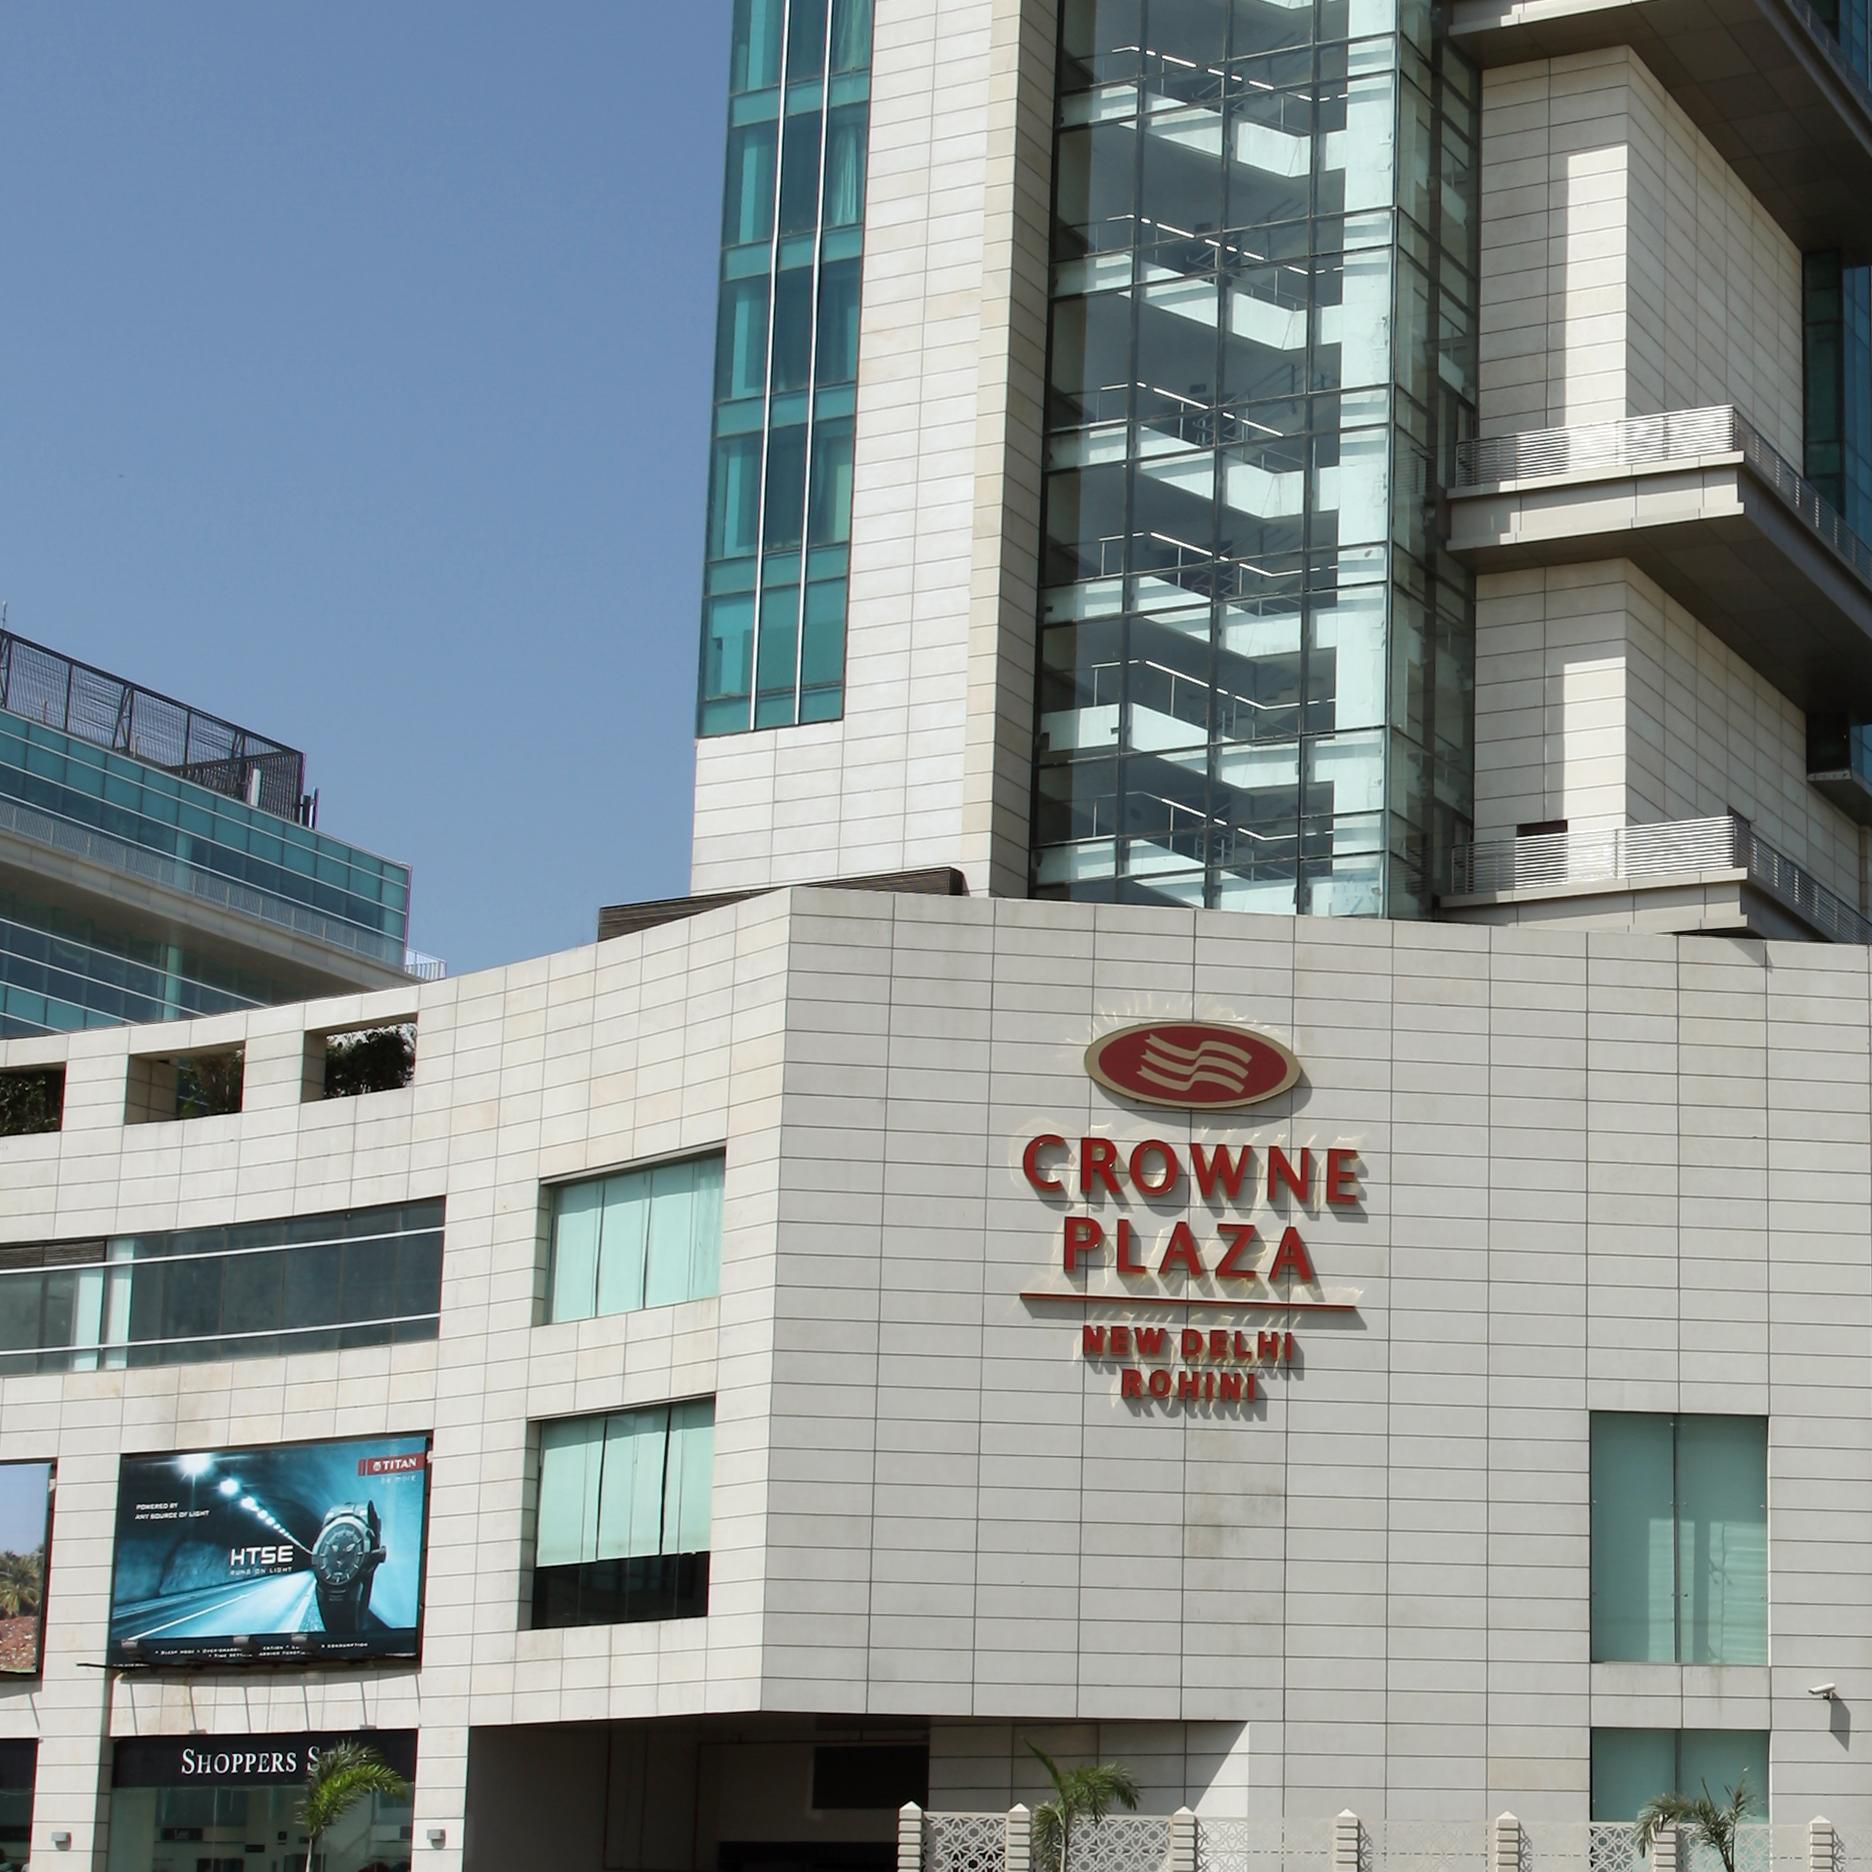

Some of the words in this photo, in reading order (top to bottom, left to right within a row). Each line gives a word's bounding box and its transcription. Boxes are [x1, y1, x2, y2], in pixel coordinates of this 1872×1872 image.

[1022, 1132, 1359, 1205] CROWNE
[1062, 1215, 1313, 1282] PLAZA
[1082, 1324, 1167, 1358] NEW
[1180, 1328, 1293, 1361] DELHI
[1120, 1368, 1256, 1404] ROHINI
[383, 1457, 417, 1471] TITAN
[135, 1502, 169, 1511] POWERED
[149, 1511, 178, 1521] SOURCE
[230, 1545, 294, 1566] HTSE
[181, 1747, 298, 1775] SHOPPERS
